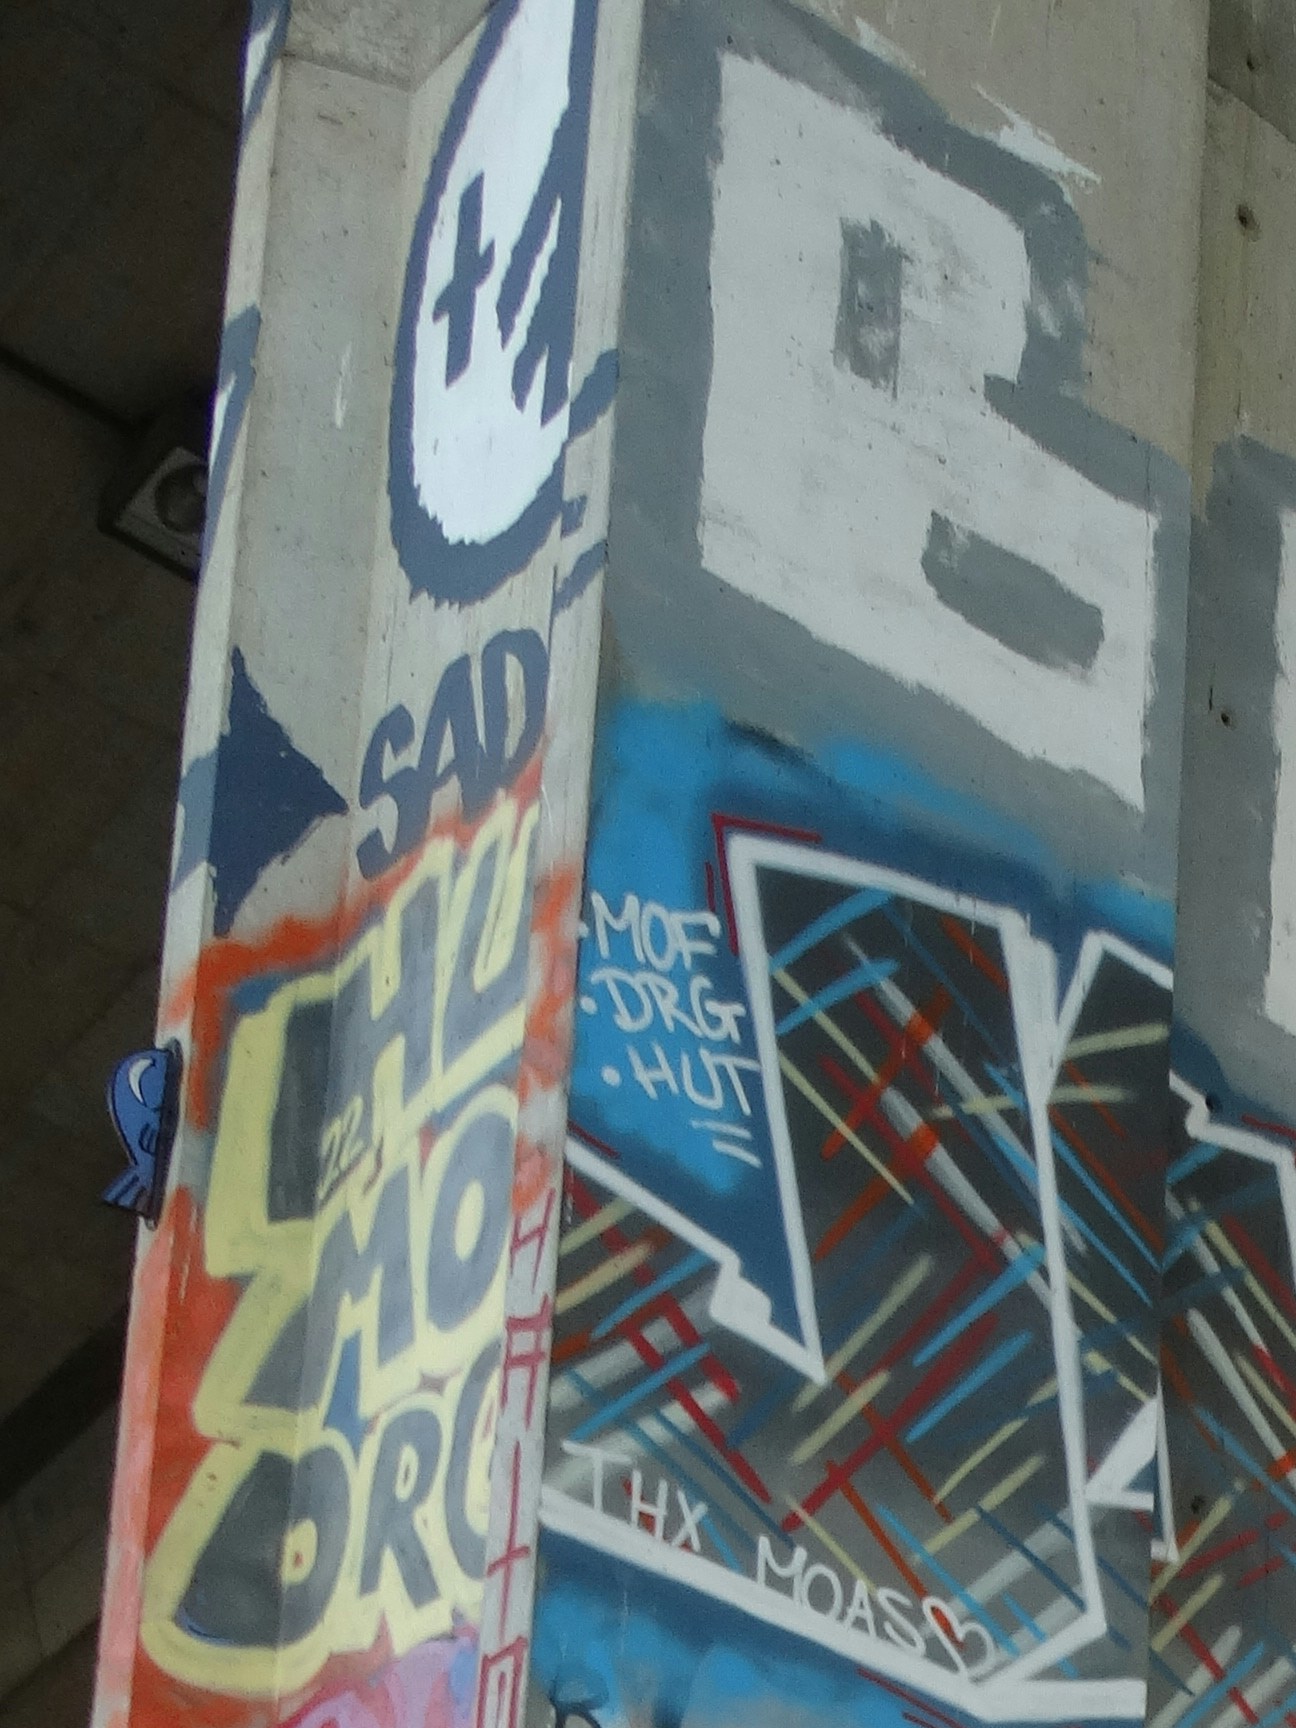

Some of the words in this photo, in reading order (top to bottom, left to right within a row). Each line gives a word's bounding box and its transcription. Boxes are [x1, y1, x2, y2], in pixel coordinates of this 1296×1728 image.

[355, 628, 550, 882] SAD
[590, 890, 721, 972] MOF
[590, 966, 747, 1046] DRG
[625, 1040, 764, 1118] HUT
[562, 1438, 708, 1553] THX
[756, 1533, 926, 1660] MOAS
